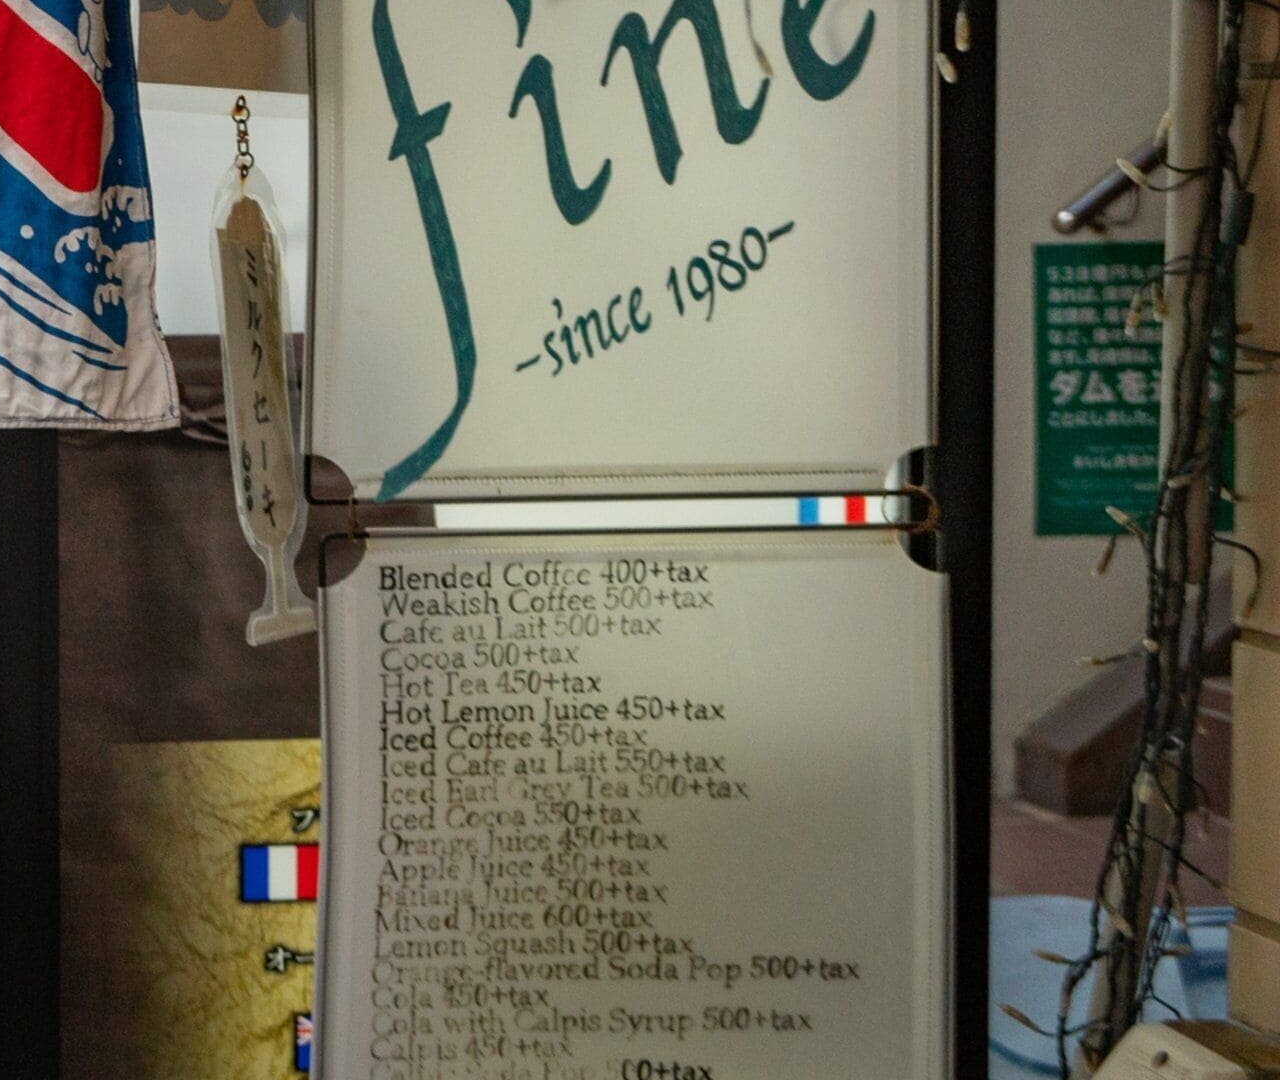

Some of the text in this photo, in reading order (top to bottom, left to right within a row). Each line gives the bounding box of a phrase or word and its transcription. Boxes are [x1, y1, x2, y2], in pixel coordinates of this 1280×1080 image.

[379, 561, 710, 591] Blended Coffee 400+tax
[381, 587, 714, 616] Weakish Coffee 500+tax
[453, 622, 486, 642] au
[496, 617, 546, 640] Lait
[554, 613, 663, 637] 500+tax
[381, 643, 580, 673] Cocoa 500+tax
[380, 671, 602, 700] Hot Tea 450+tax
[380, 697, 725, 724] Hot Lemon Juice 450+tax
[379, 724, 648, 751] Iced Coffee 450+tax
[381, 754, 437, 778] Iced
[514, 757, 546, 775] au
[557, 750, 608, 773] Lait
[615, 749, 726, 773] 550+tax
[381, 780, 437, 806] Iced
[448, 778, 499, 803] Earl
[586, 777, 631, 798] Tea
[638, 775, 750, 799] 500+tax
[381, 808, 437, 832] Iced
[534, 800, 640, 823] 550+tax
[488, 831, 550, 854] Juice
[558, 827, 668, 852] 450+tax
[379, 854, 651, 887] Apple Juice 450+tax
[484, 883, 547, 904] Juice
[558, 880, 668, 904] 500+tax
[377, 905, 653, 932] Mixed Juice 600+tax
[375, 930, 694, 960] Lemon Squash 500+tax
[608, 958, 678, 980] Soda
[689, 957, 741, 988] Pop
[750, 957, 860, 981] 500+tax
[372, 985, 434, 1009] Cola
[372, 1012, 433, 1038] Cola
[608, 1008, 693, 1043] Syrup
[704, 1007, 812, 1032] 500+tax
